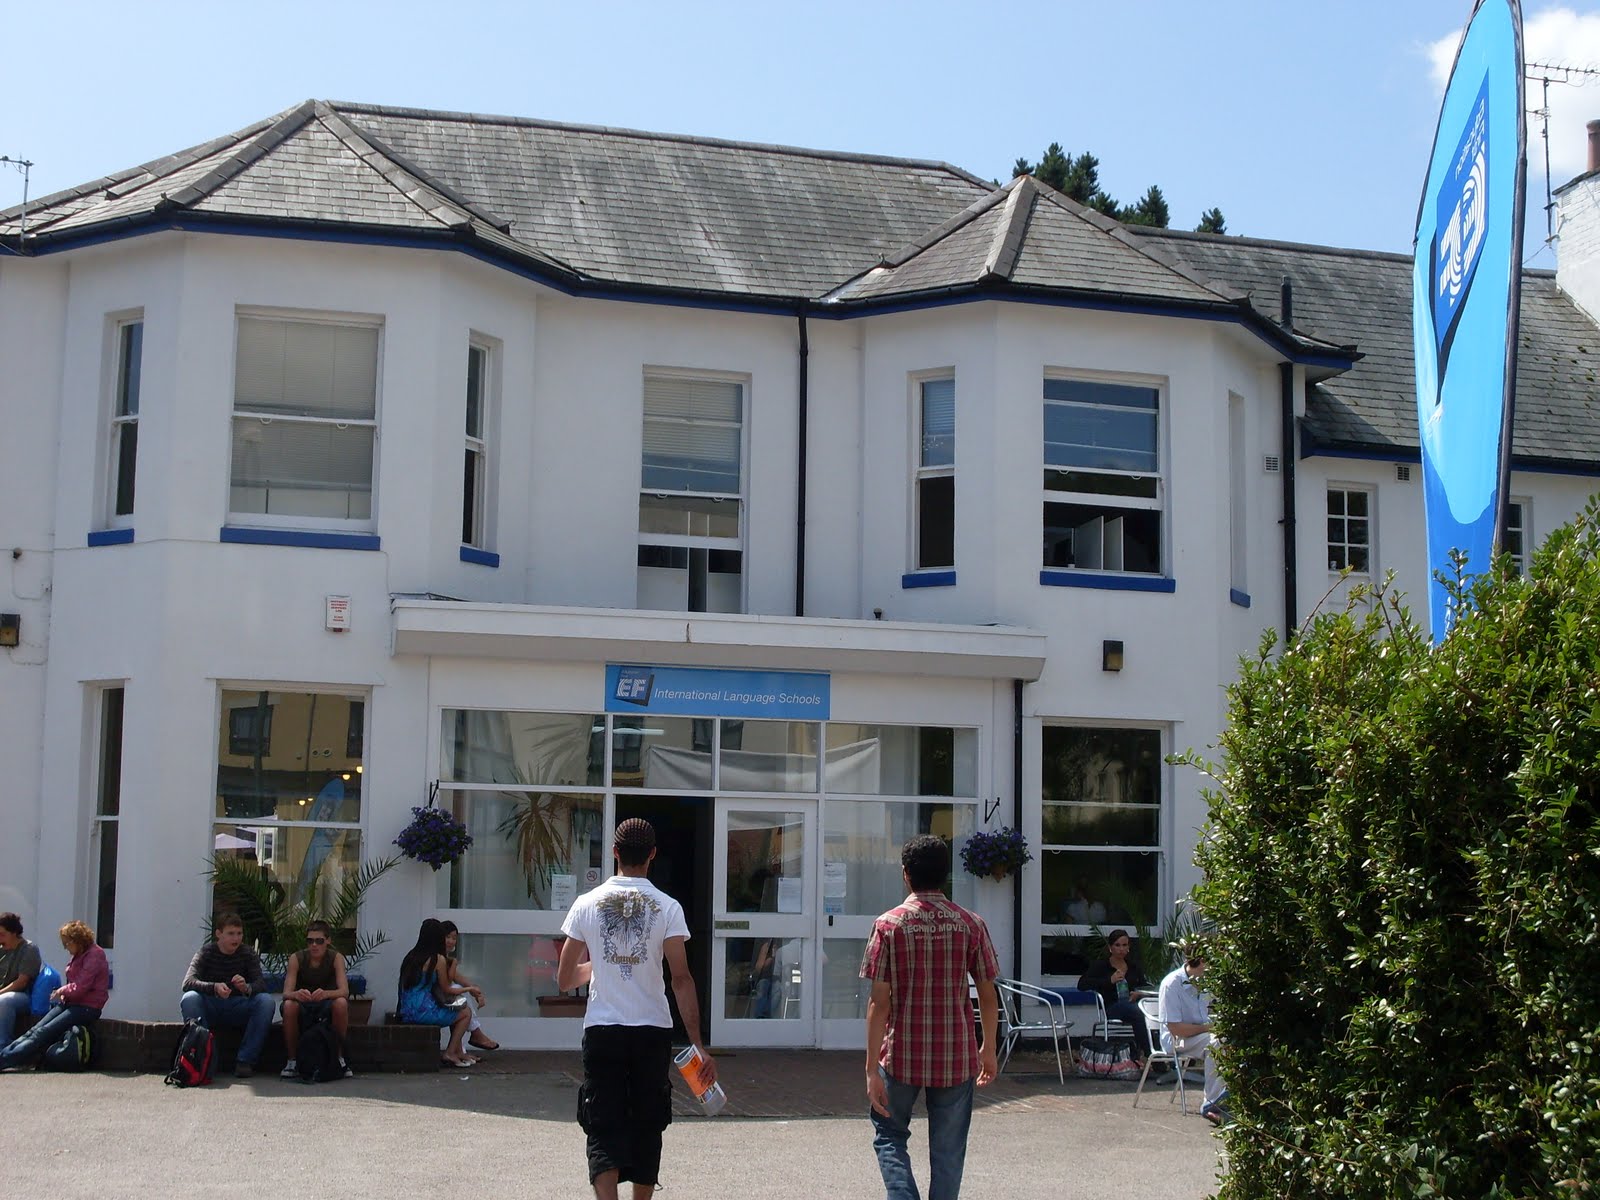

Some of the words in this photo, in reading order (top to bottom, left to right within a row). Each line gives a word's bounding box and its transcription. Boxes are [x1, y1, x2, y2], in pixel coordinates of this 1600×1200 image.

[616, 678, 646, 698] EF
[654, 687, 721, 701] International
[723, 690, 776, 705] Language
[778, 692, 821, 705] Schools
[901, 911, 935, 921] RACING
[937, 910, 961, 920] CLUB
